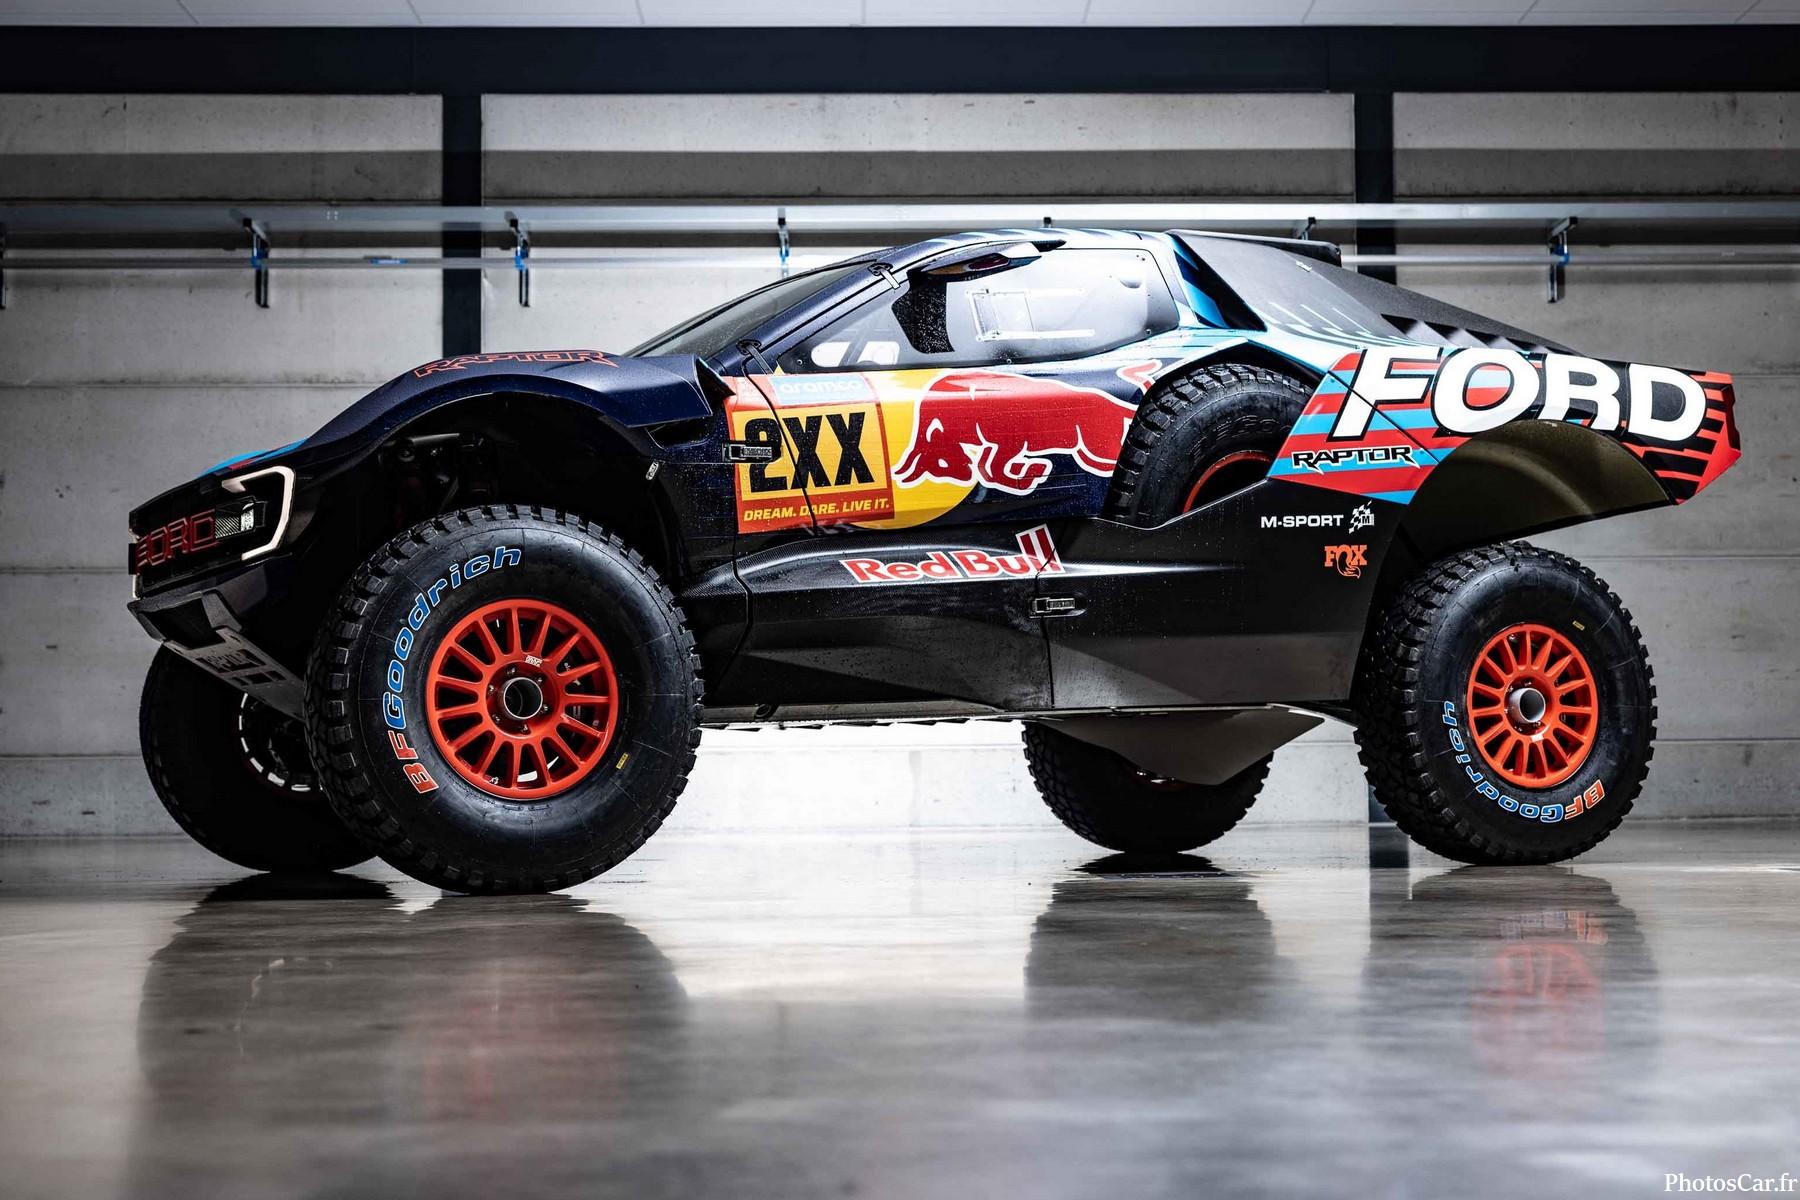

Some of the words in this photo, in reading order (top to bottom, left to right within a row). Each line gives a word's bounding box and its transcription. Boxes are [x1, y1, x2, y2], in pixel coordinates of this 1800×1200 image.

[414, 351, 620, 378] RAPTOR
[780, 380, 862, 393] aramco
[1327, 347, 1706, 441] FORD
[744, 411, 875, 493] 2XX
[1291, 445, 1421, 475] RAPTOR
[743, 507, 797, 521] DREAM.
[800, 502, 839, 516] DARE.
[842, 499, 872, 513] LIVE
[874, 498, 890, 510] IT.
[1260, 515, 1344, 528] M-SPORT
[839, 551, 963, 583] Red
[950, 523, 1066, 578] Bull
[1324, 544, 1368, 569] FOX
